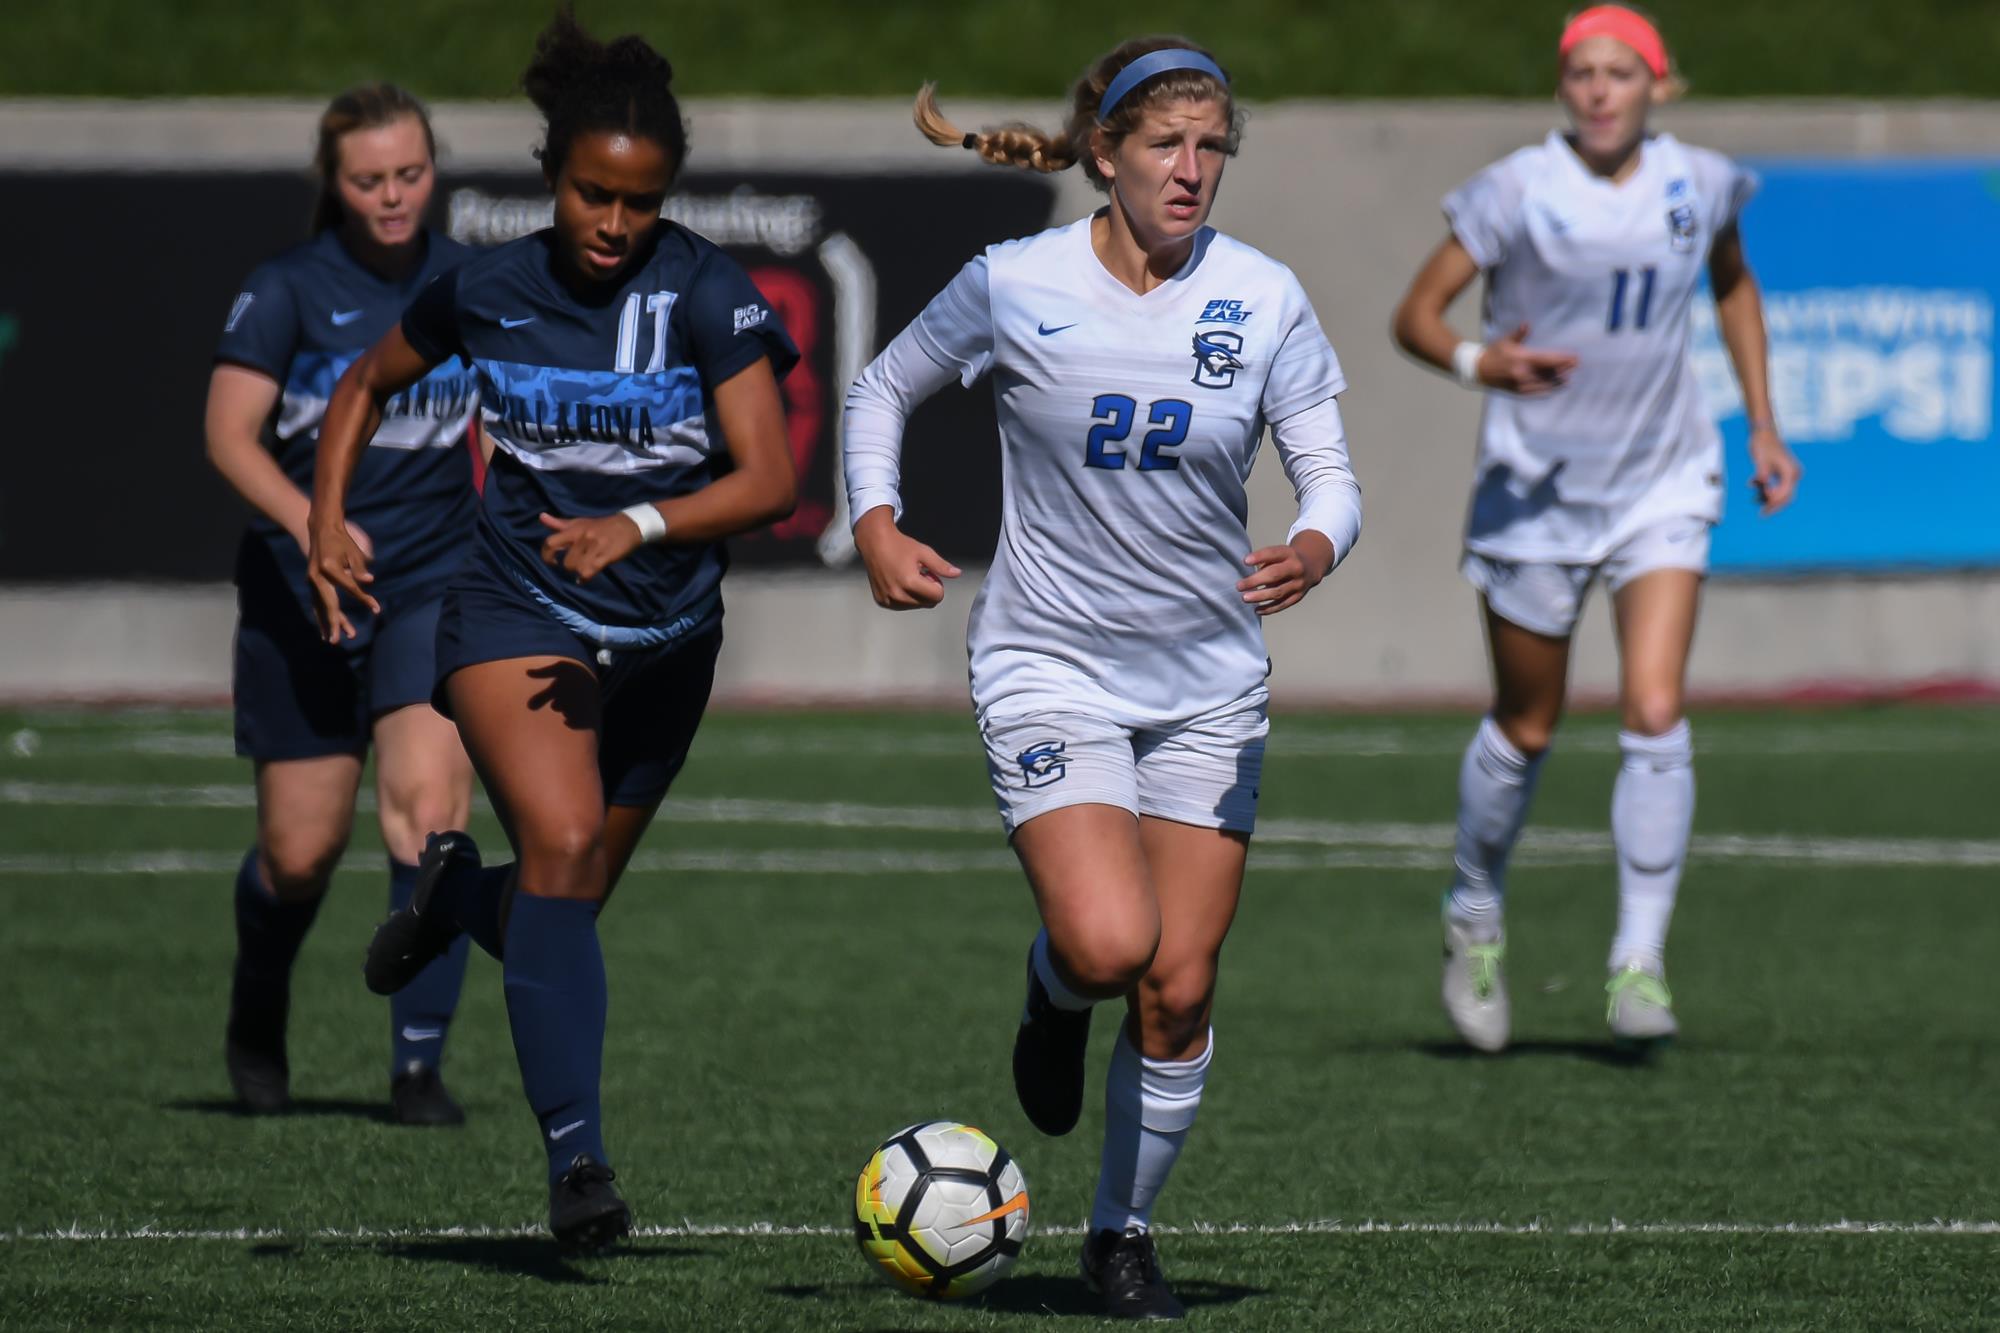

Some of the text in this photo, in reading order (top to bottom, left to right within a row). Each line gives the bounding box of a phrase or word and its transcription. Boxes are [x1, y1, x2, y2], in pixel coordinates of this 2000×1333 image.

[1199, 311, 1252, 322] EAST
[1205, 300, 1243, 311] BIG
[1607, 268, 1656, 333] 11
[1083, 394, 1193, 470] 22
